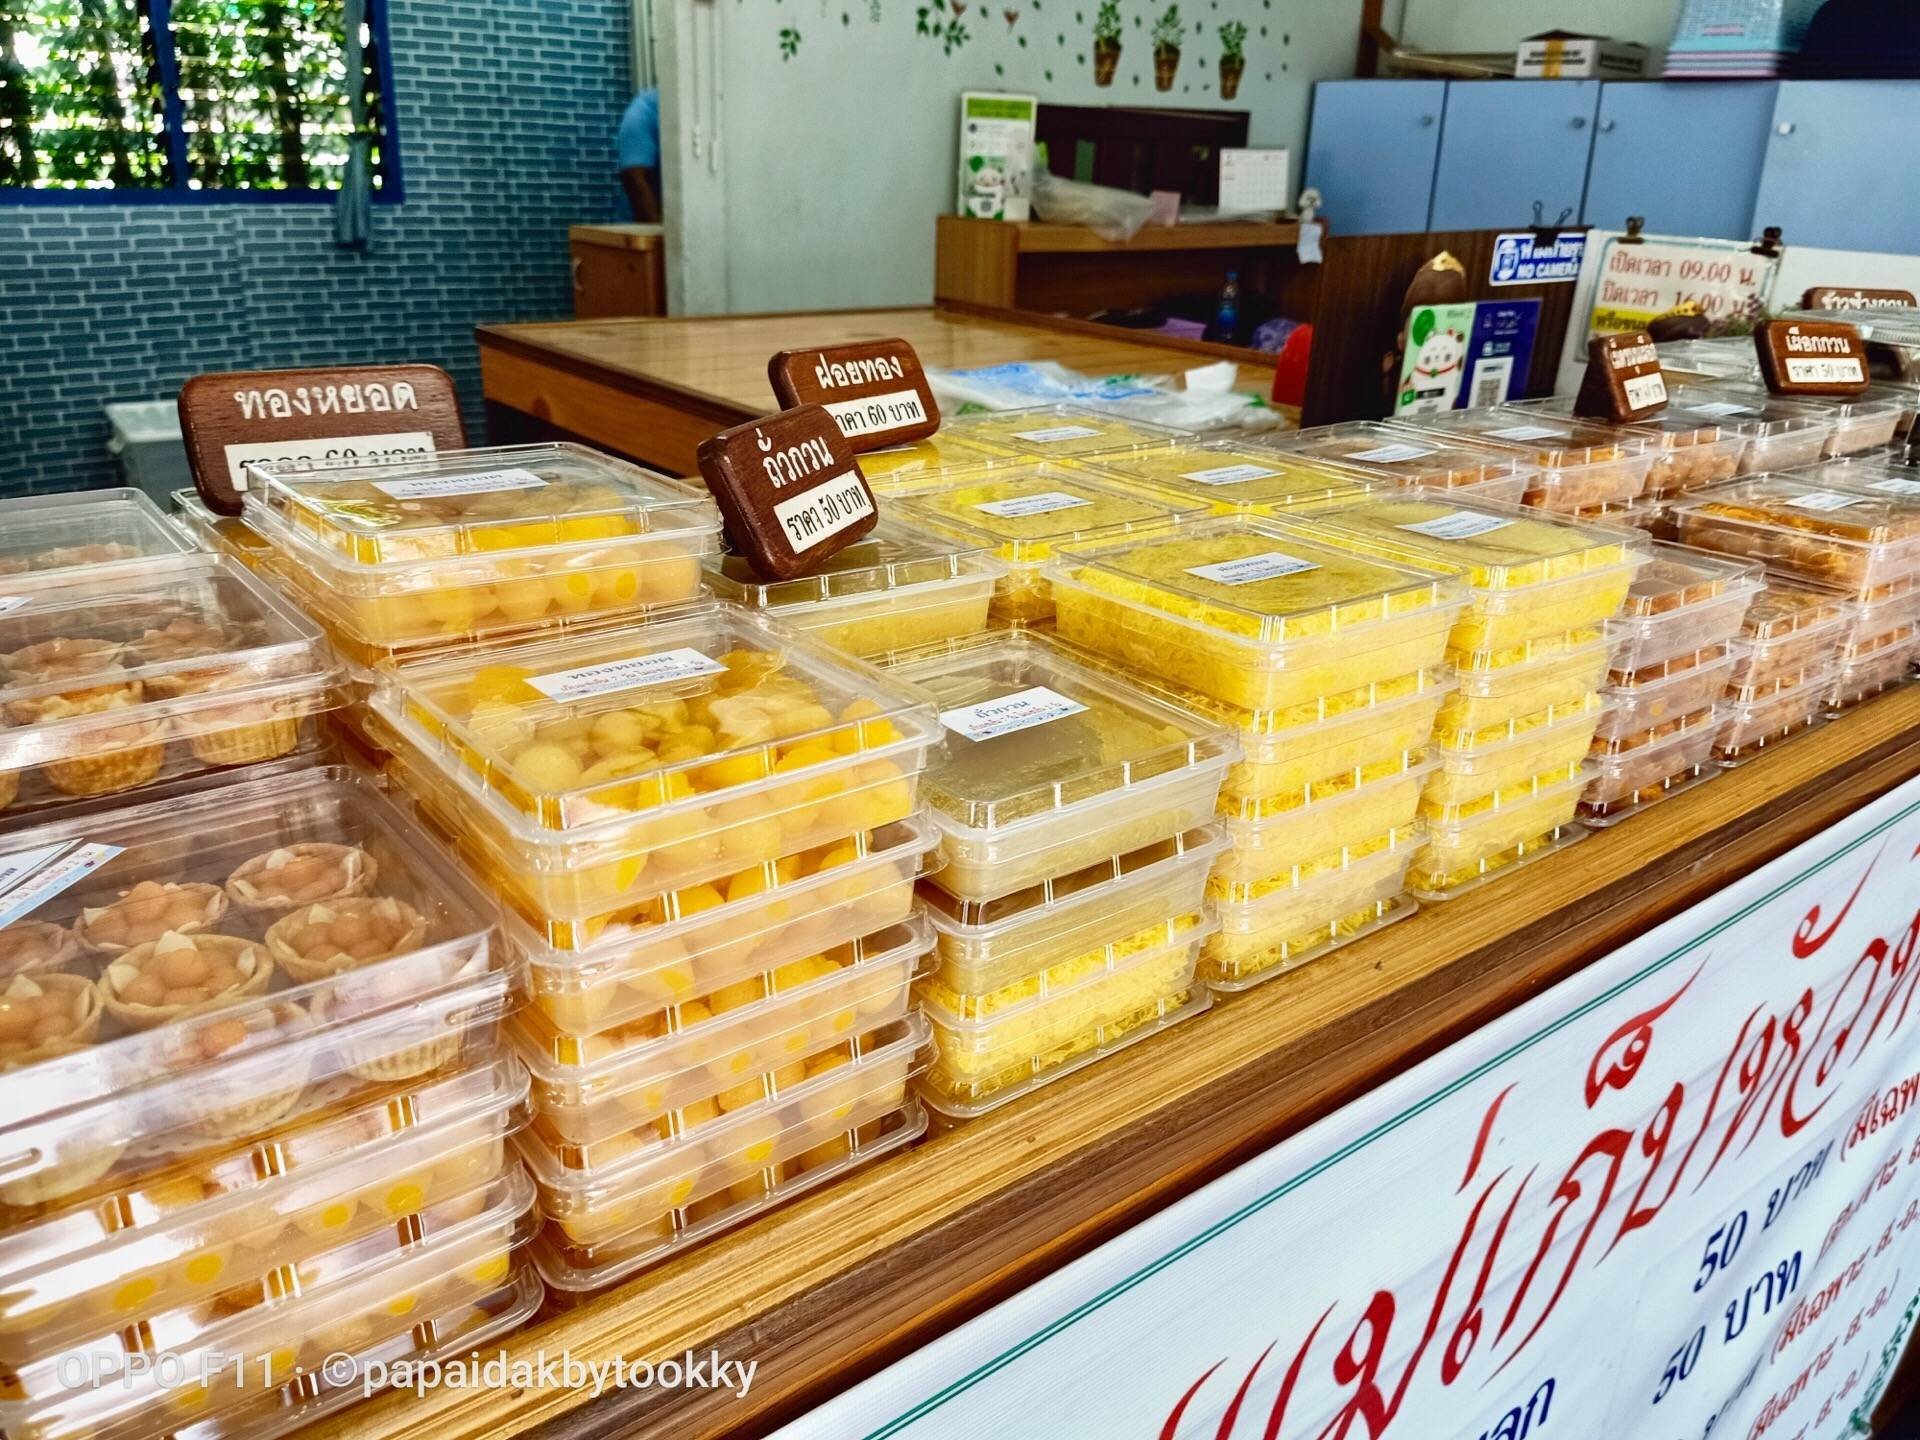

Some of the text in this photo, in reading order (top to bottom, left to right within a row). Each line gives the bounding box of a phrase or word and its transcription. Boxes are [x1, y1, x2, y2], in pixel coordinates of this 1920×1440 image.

[1516, 264, 1535, 279] NO
[1609, 251, 1756, 287] เปิดเวลา 09.00 น.
[1602, 280, 1660, 306] ปิดเวลา
[1785, 326, 1852, 354] เผือกกวน
[814, 353, 904, 389] ฝอยทอง
[233, 381, 418, 420] ทองหยอด
[835, 400, 921, 432] าคา 60 บาท
[755, 428, 835, 489] ถั่วกวน
[786, 484, 867, 541] ราคา 50 บาท
[973, 698, 1031, 720] ถั่วกวน
[1693, 1210, 1748, 1292] 50
[1653, 1324, 1706, 1405] 50
[1724, 1250, 1802, 1344] บาท
